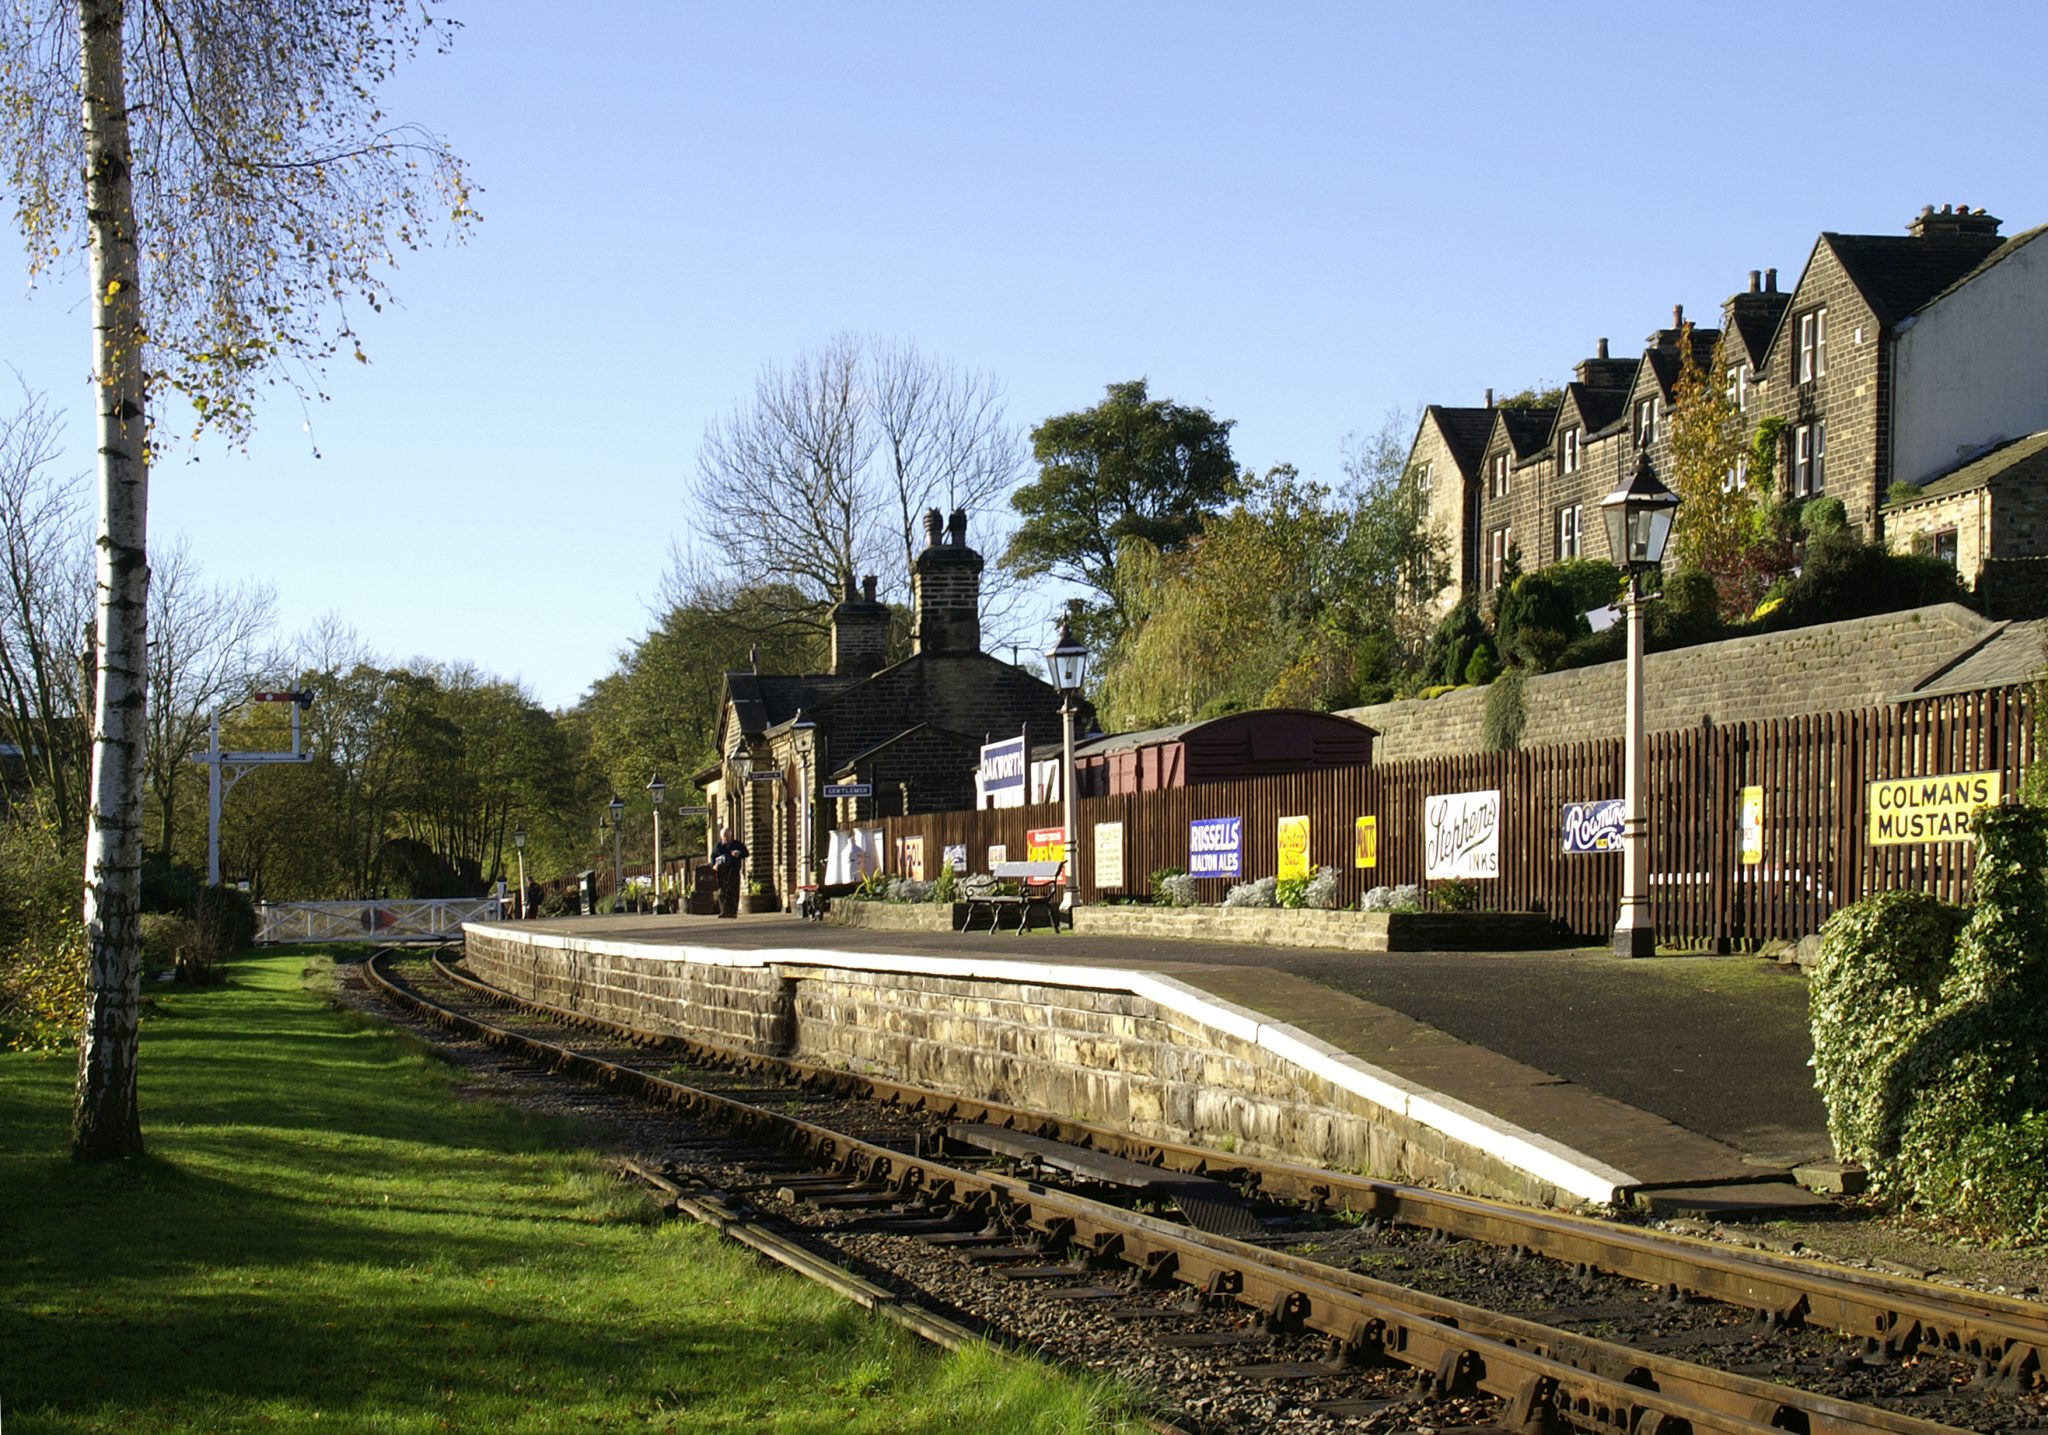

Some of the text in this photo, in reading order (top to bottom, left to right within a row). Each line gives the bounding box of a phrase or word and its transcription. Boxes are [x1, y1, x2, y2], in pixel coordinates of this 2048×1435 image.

[984, 751, 1023, 782] OAKWORTH
[1564, 802, 1626, 851] Rowntre
[1878, 811, 1969, 839] MUSTAR
[1191, 852, 1239, 872] MALTON ALES
[1468, 852, 1497, 872] INKS
